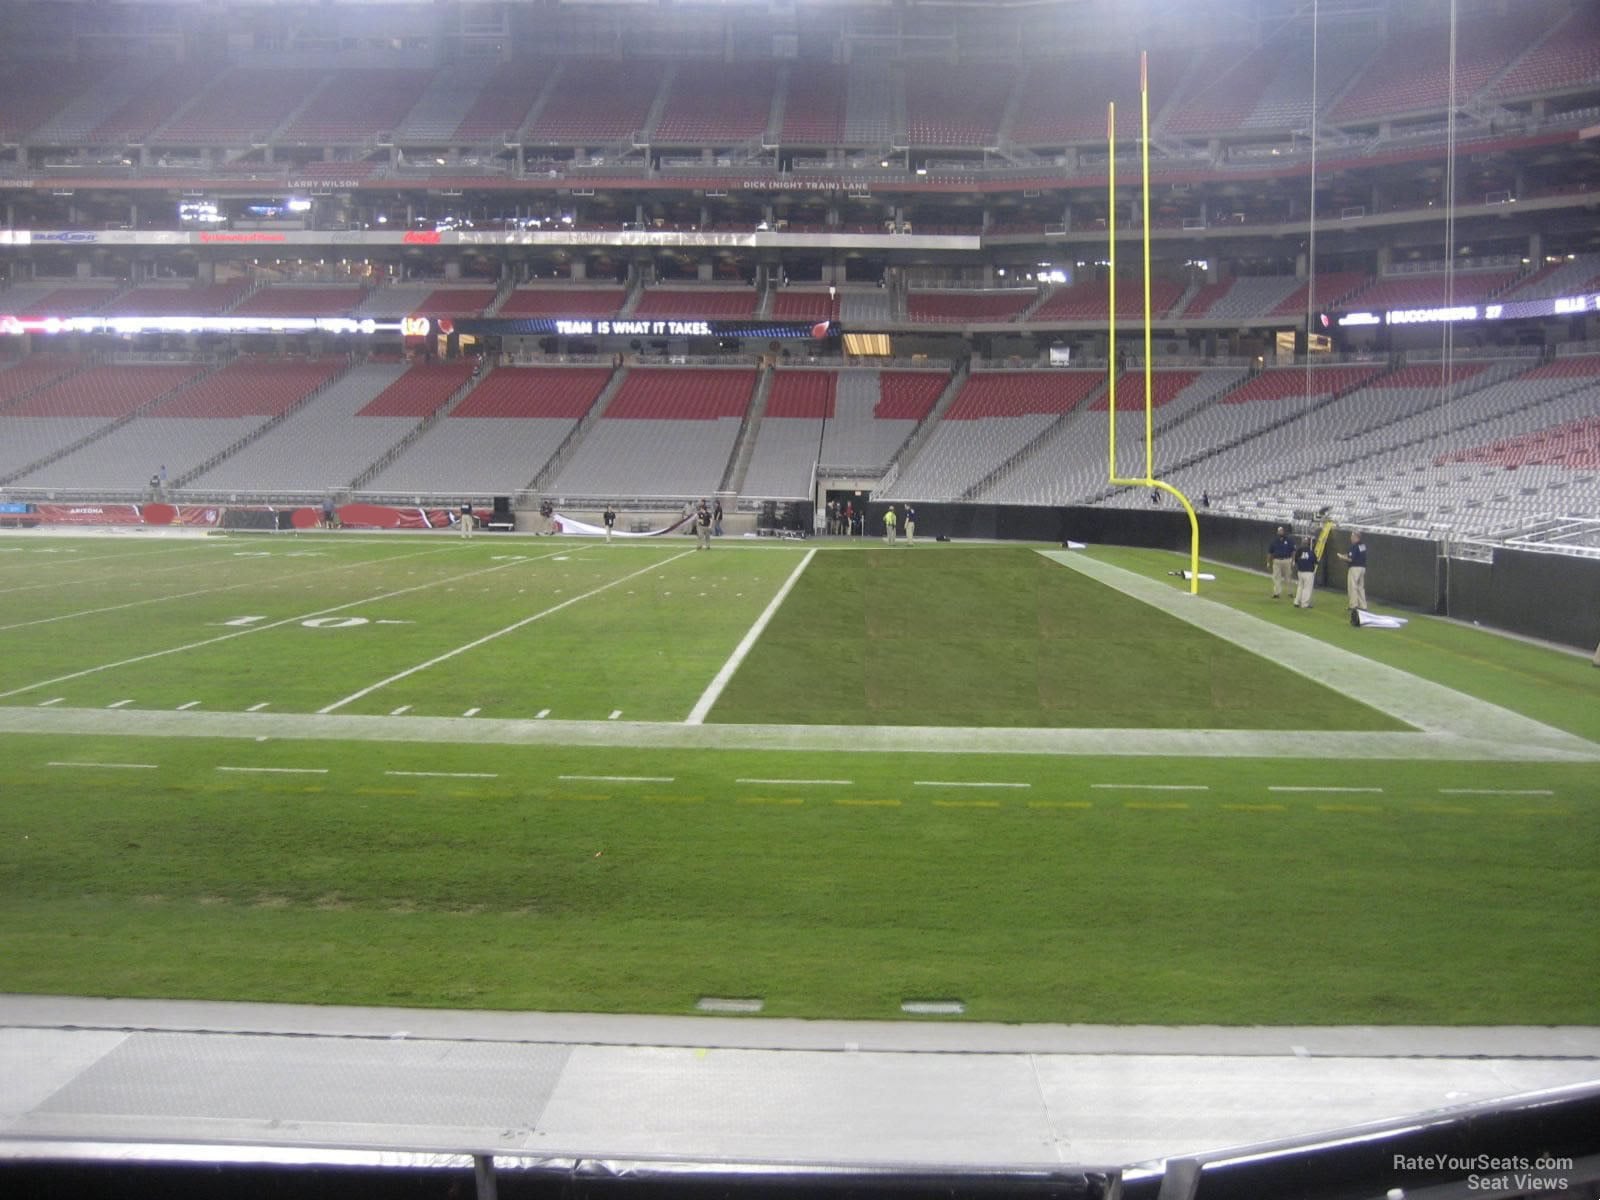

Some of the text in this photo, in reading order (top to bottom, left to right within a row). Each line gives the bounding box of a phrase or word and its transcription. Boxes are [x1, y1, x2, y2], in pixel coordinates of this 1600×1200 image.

[287, 180, 359, 188] LARRY WILSON
[743, 181, 868, 190] DICK (NIGHT TRAIN) LANE
[556, 321, 712, 334] TEAM IS WHAT IT TAKES.
